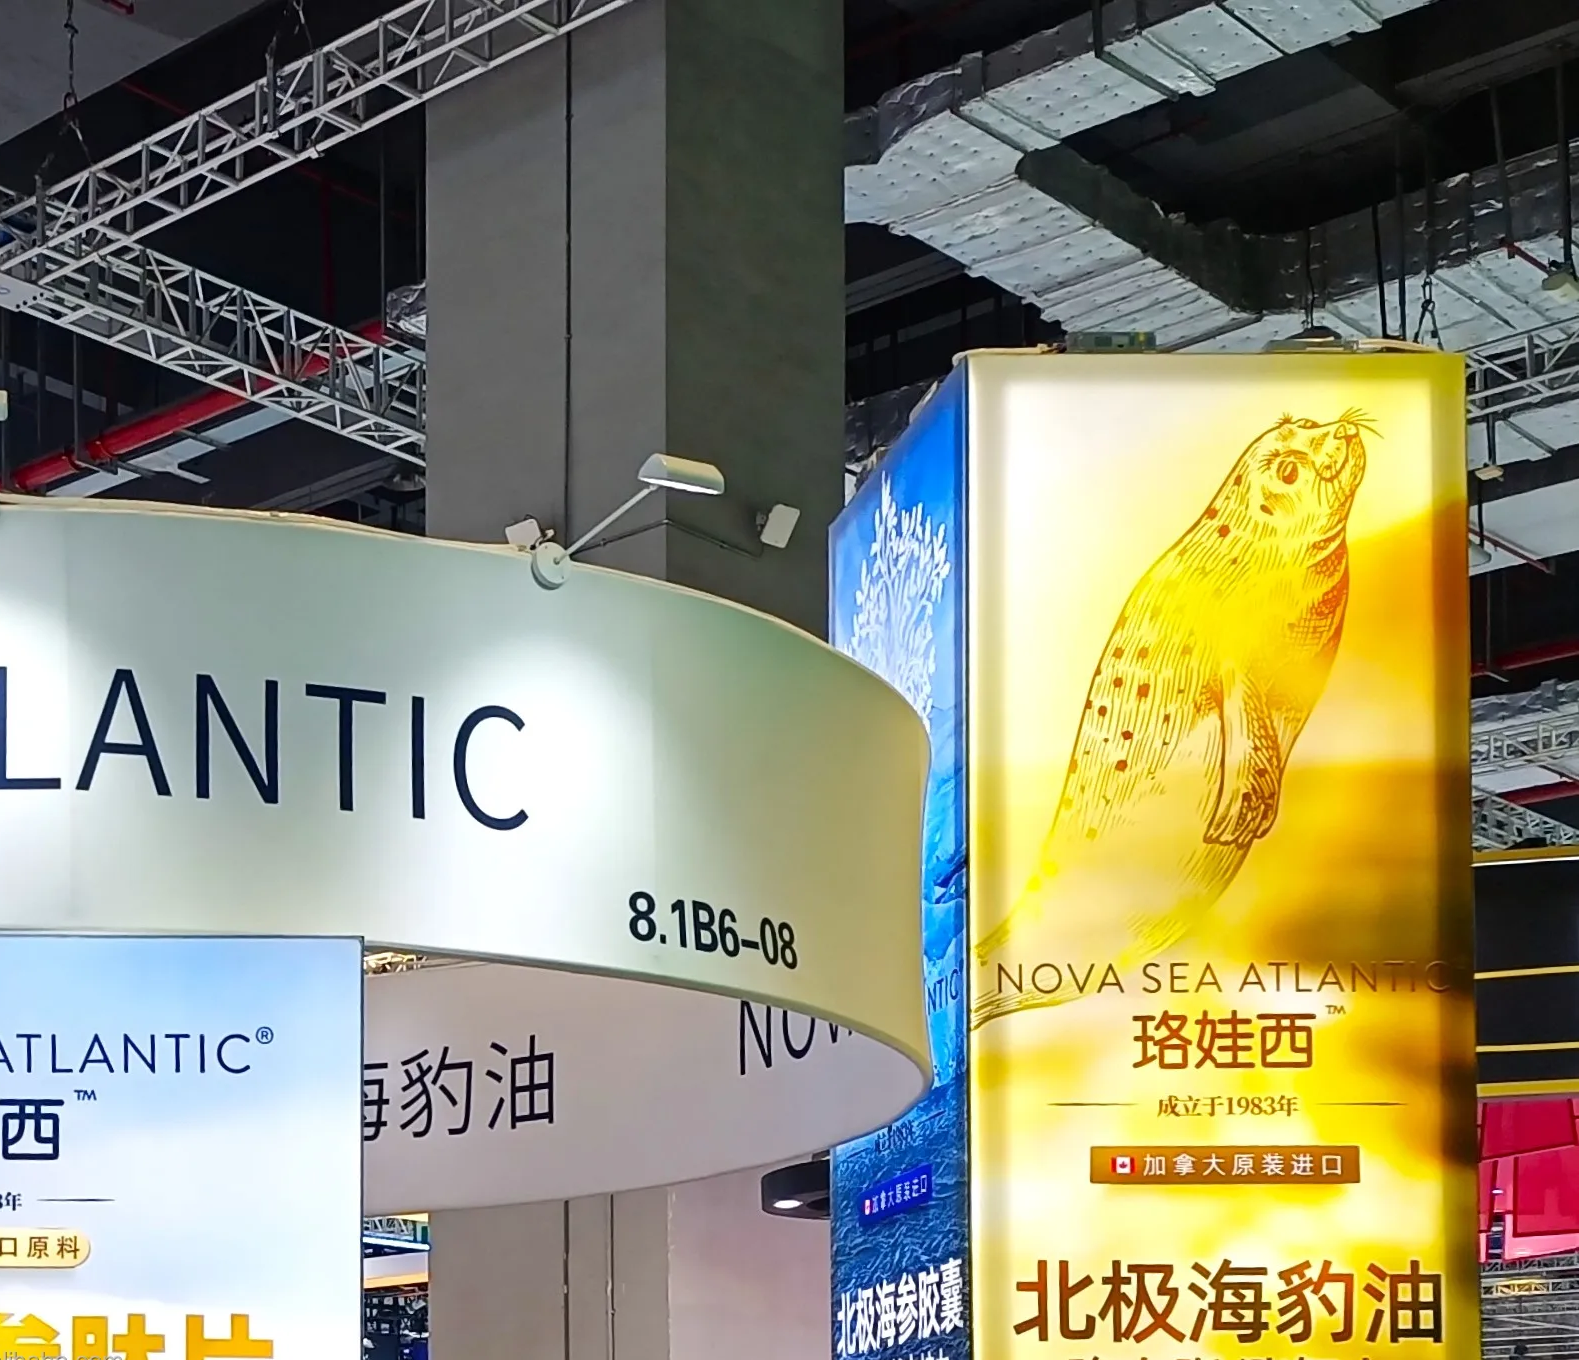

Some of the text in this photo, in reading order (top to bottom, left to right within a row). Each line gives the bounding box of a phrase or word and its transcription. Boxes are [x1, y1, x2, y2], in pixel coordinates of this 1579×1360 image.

[628, 890, 799, 970] 8.1B6-08
[996, 961, 1123, 995] NOVA
[1141, 961, 1223, 995] SEA
[1156, 1094, 1299, 1119] 成立于1983年
[1142, 1152, 1344, 1179] 加拿大原装进口
[836, 1257, 964, 1358] 北极海参胶囊
[1012, 1258, 1444, 1346] 北极海豹油
